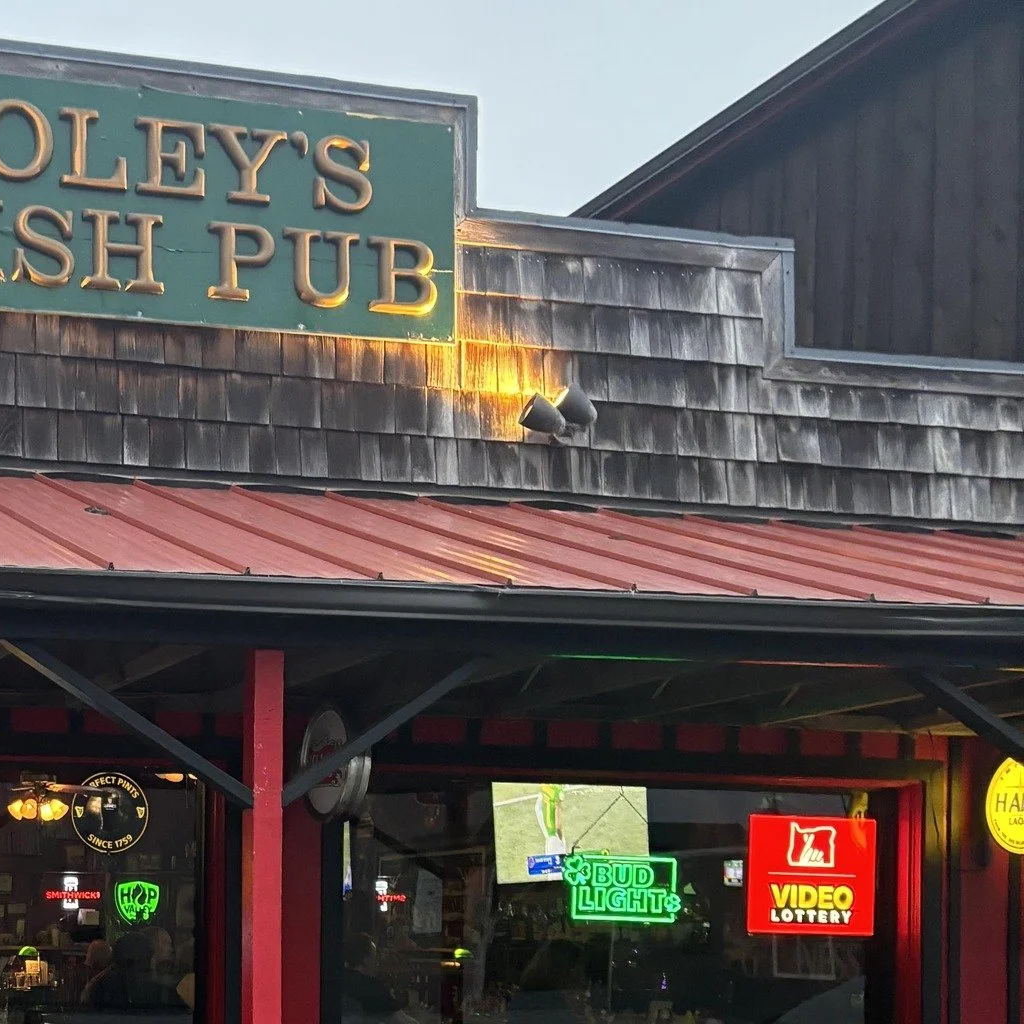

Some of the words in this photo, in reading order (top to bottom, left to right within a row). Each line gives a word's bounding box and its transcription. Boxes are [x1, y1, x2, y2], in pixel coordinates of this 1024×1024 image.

[207, 221, 437, 316] PUB
[117, 777, 139, 798] PINTS
[996, 793, 1024, 813] HA
[87, 834, 113, 849] SINCE
[114, 833, 133, 848] 1759
[591, 863, 655, 887] BUD
[579, 886, 666, 913] LIGHT
[770, 884, 854, 909] VIDEO
[770, 909, 852, 924] LOTTERY
